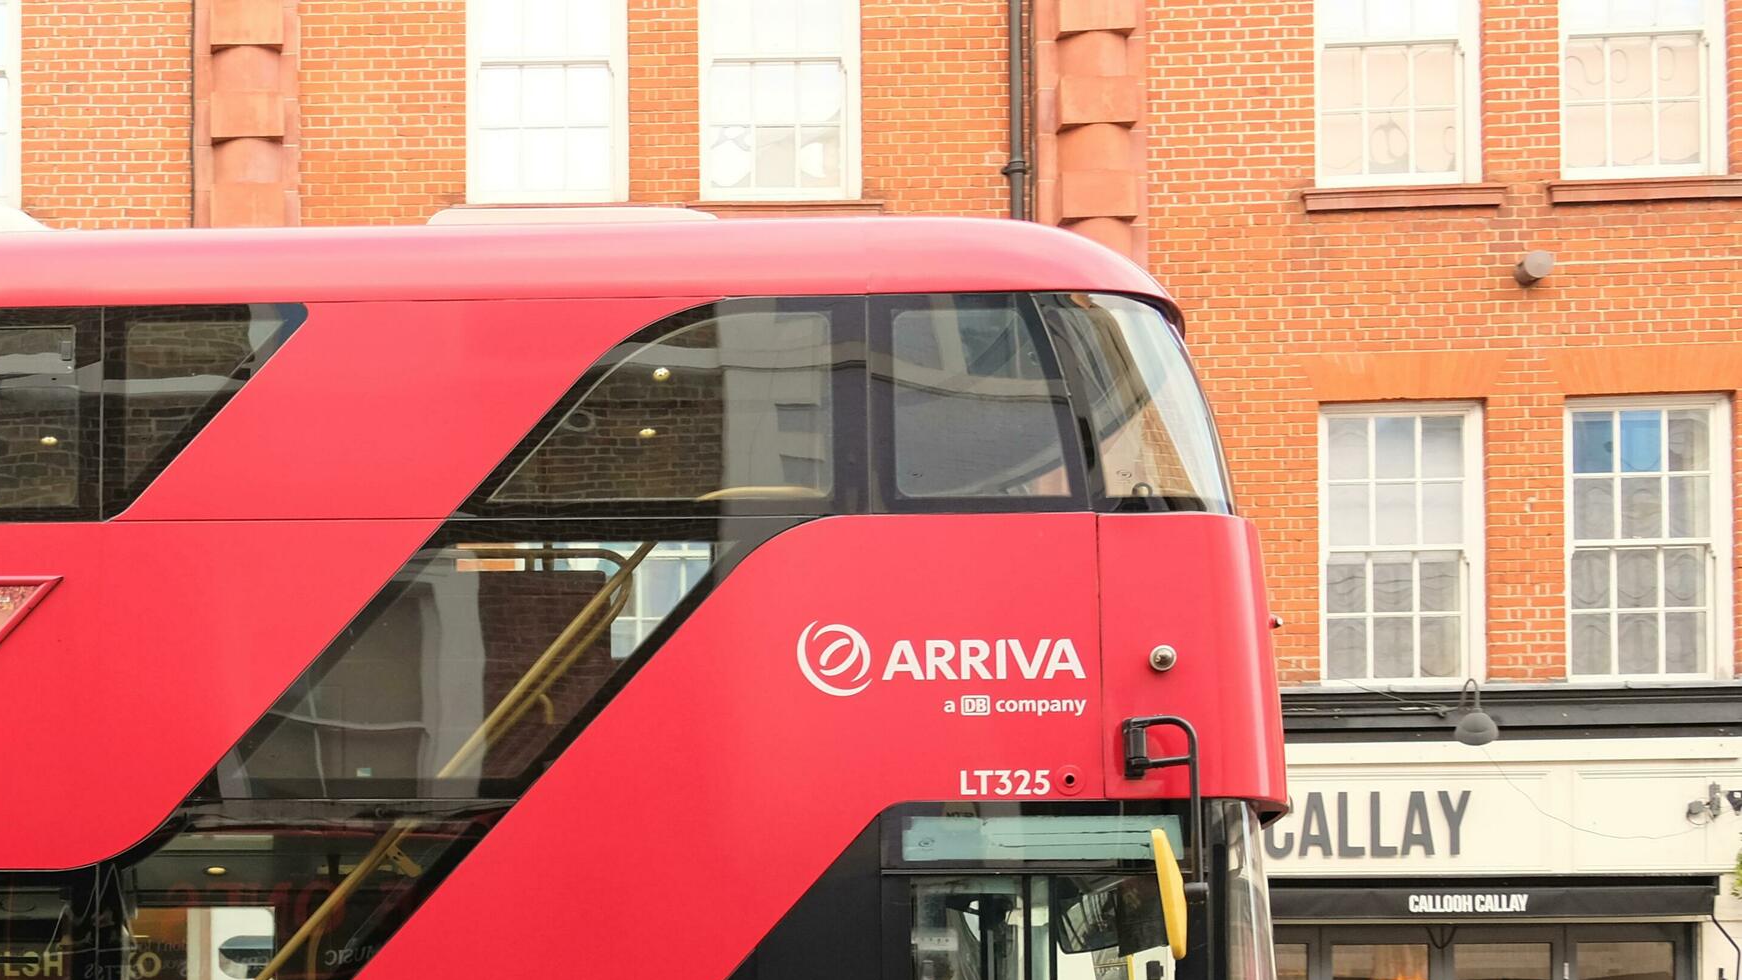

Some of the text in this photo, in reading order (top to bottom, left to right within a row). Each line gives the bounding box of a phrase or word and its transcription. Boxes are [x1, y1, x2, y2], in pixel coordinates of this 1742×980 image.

[882, 638, 1087, 681] ARRIVA
[943, 697, 1087, 717] a DB company
[960, 769, 1051, 796] LT325
[1264, 790, 1471, 860] CALLAY
[1408, 893, 1529, 913] CALLOOH CALLAY
